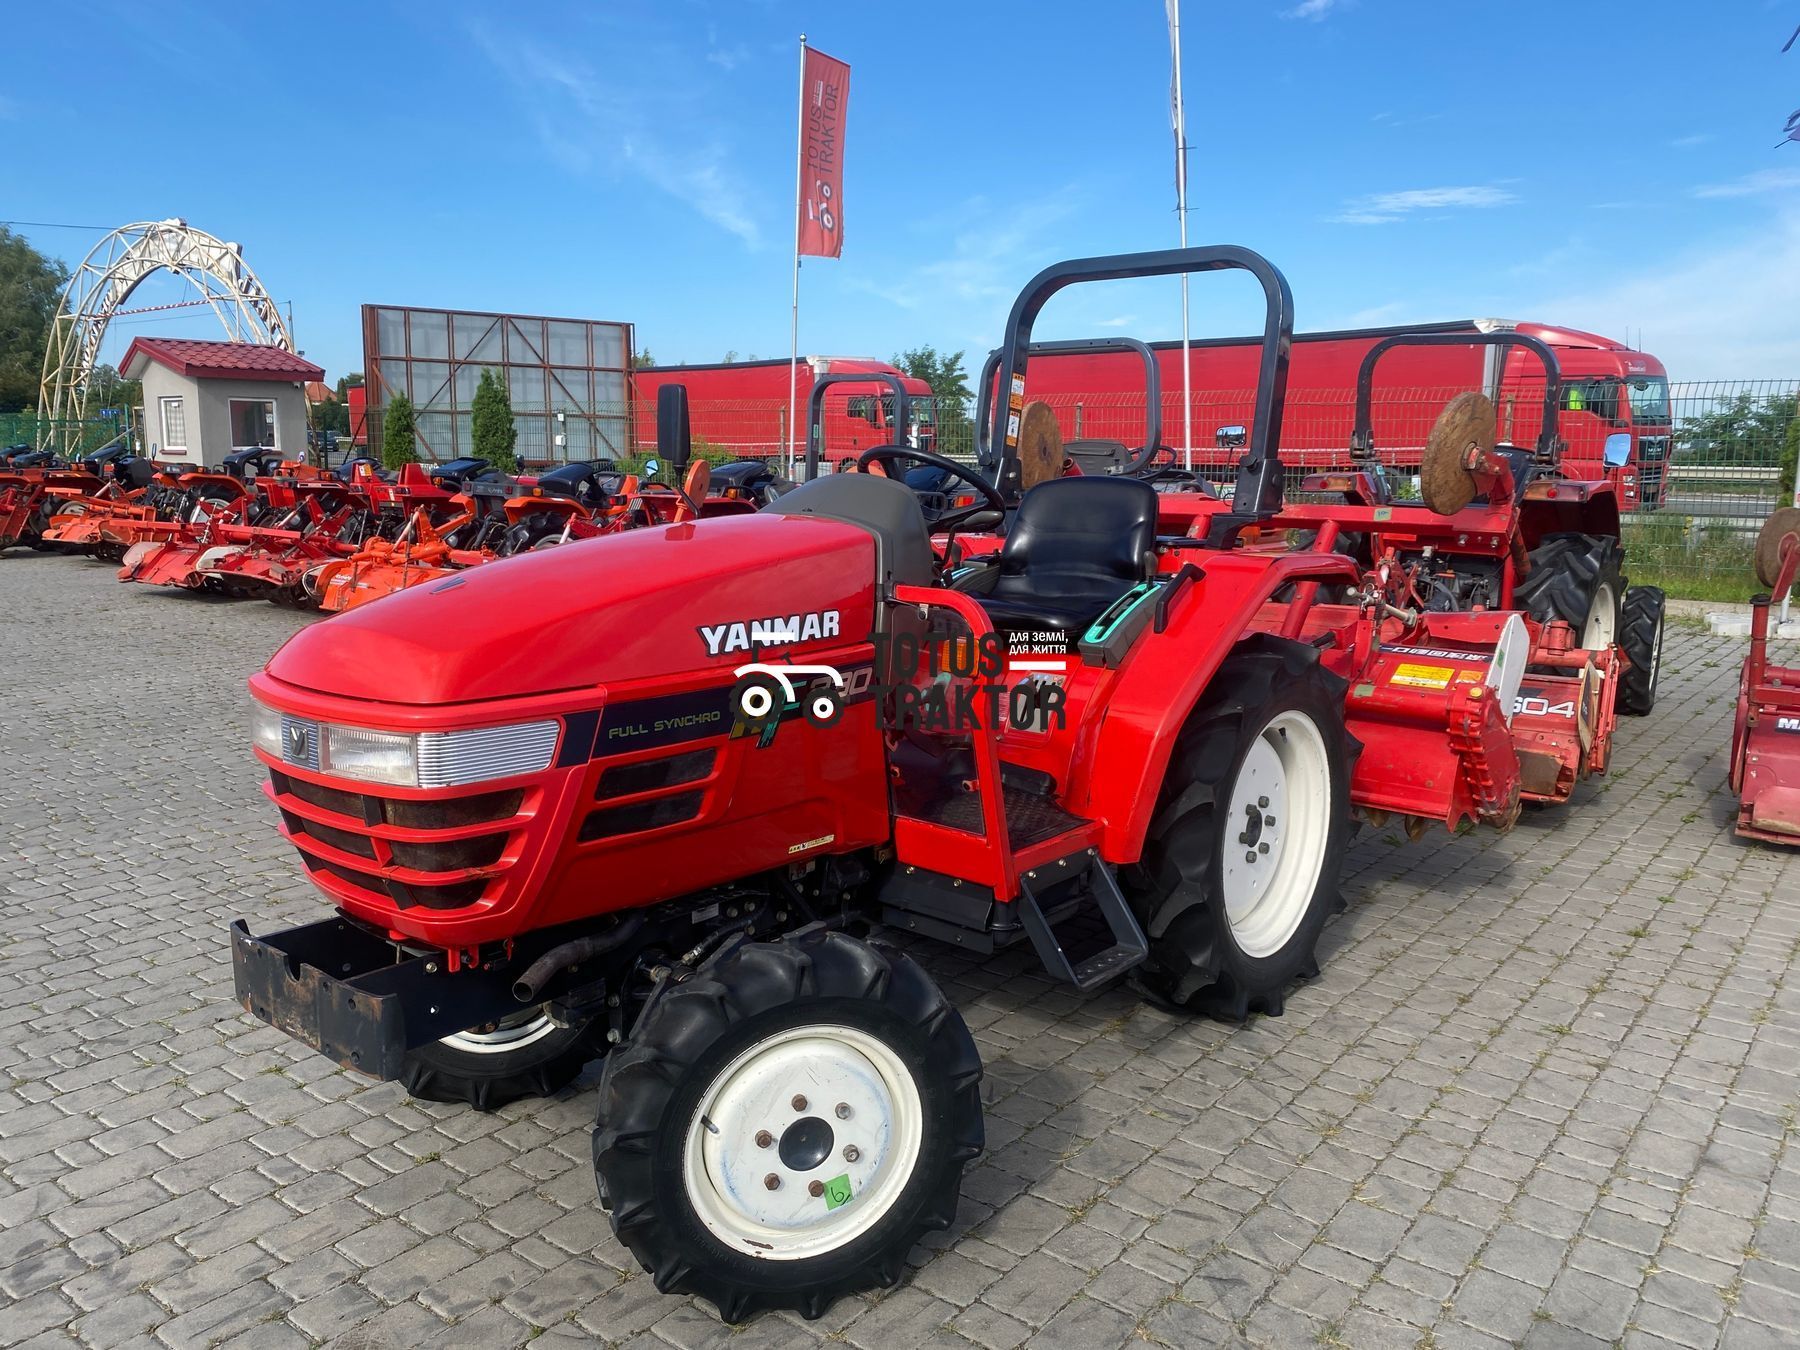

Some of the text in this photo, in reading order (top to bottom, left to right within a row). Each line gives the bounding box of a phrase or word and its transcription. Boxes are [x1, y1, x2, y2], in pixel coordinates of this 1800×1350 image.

[807, 105, 822, 169] TOTUS
[820, 84, 839, 174] TRAKTOR
[698, 610, 840, 656] YANMAR
[608, 710, 720, 739] FULL SYNCHRO
